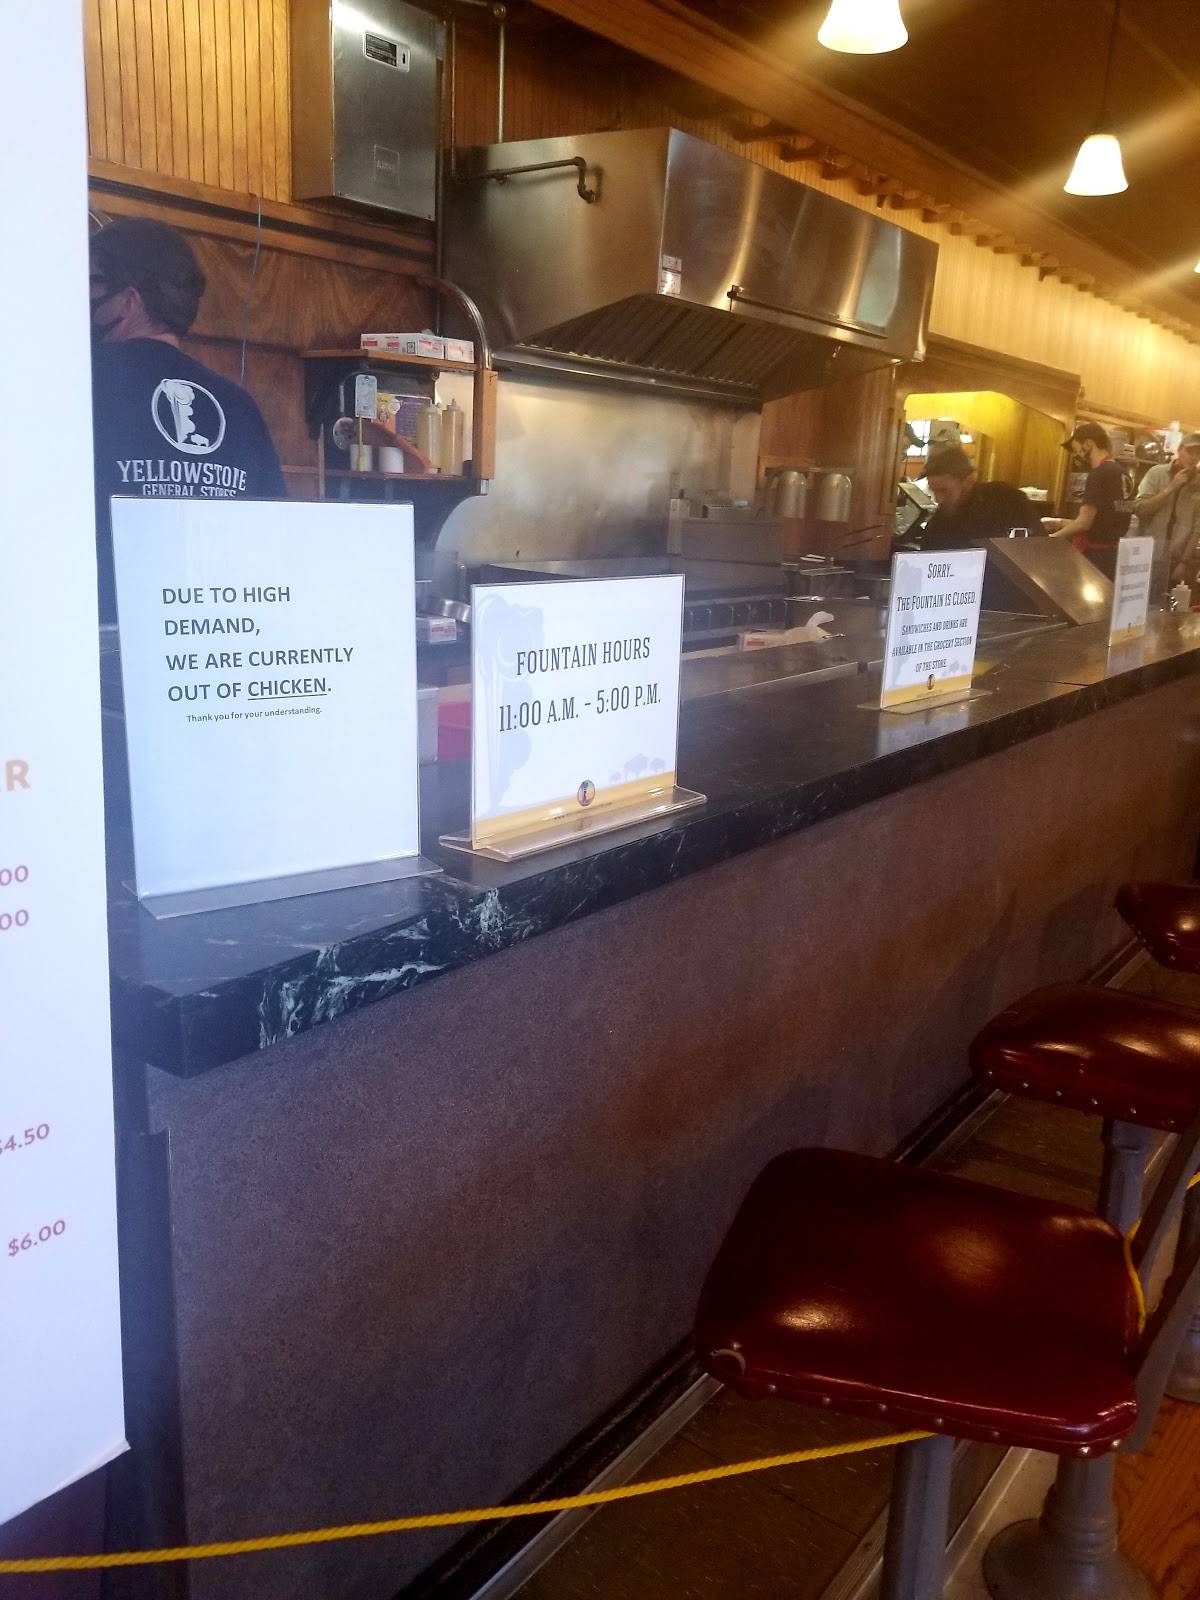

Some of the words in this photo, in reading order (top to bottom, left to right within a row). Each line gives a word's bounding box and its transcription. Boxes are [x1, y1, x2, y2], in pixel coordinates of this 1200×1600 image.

[162, 587, 204, 604] DUE
[209, 587, 237, 603] TO
[243, 586, 291, 603] HIGH
[897, 597, 910, 611] THE
[911, 594, 943, 611] FOUNTAIN
[945, 594, 951, 607] IS
[164, 617, 261, 636] DEMAND,
[902, 623, 932, 635] SANDWICHES
[933, 622, 942, 631] AND
[943, 620, 959, 630] DRINKS
[959, 617, 968, 629] ARE
[516, 642, 598, 676] FOUNTAIN
[602, 636, 651, 665] HOURS
[893, 645, 917, 656] AVAILABLE
[918, 644, 924, 653] IN
[924, 641, 933, 652] THE
[934, 639, 954, 650] GROCERY
[954, 635, 972, 647] SECTION
[166, 654, 199, 671] WE
[205, 652, 243, 669] ARE
[248, 647, 354, 667] CURRENTLY
[915, 663, 922, 673] OF
[922, 661, 931, 672] THE
[168, 684, 211, 702] OUT
[216, 682, 242, 699] OF
[247, 677, 332, 699] CHICKEN.
[187, 714, 213, 723] Thank
[214, 713, 230, 723] you
[230, 711, 243, 720] for
[244, 711, 264, 720] your
[264, 706, 323, 718] understanding.
[499, 699, 542, 732] 11:00
[547, 696, 579, 724] A.M.
[596, 685, 630, 715] 5:00
[634, 682, 661, 708] P.M.
[0, 759, 31, 792] R
[0, 1123, 50, 1156] 4.50
[8, 1219, 66, 1257] $6.00
